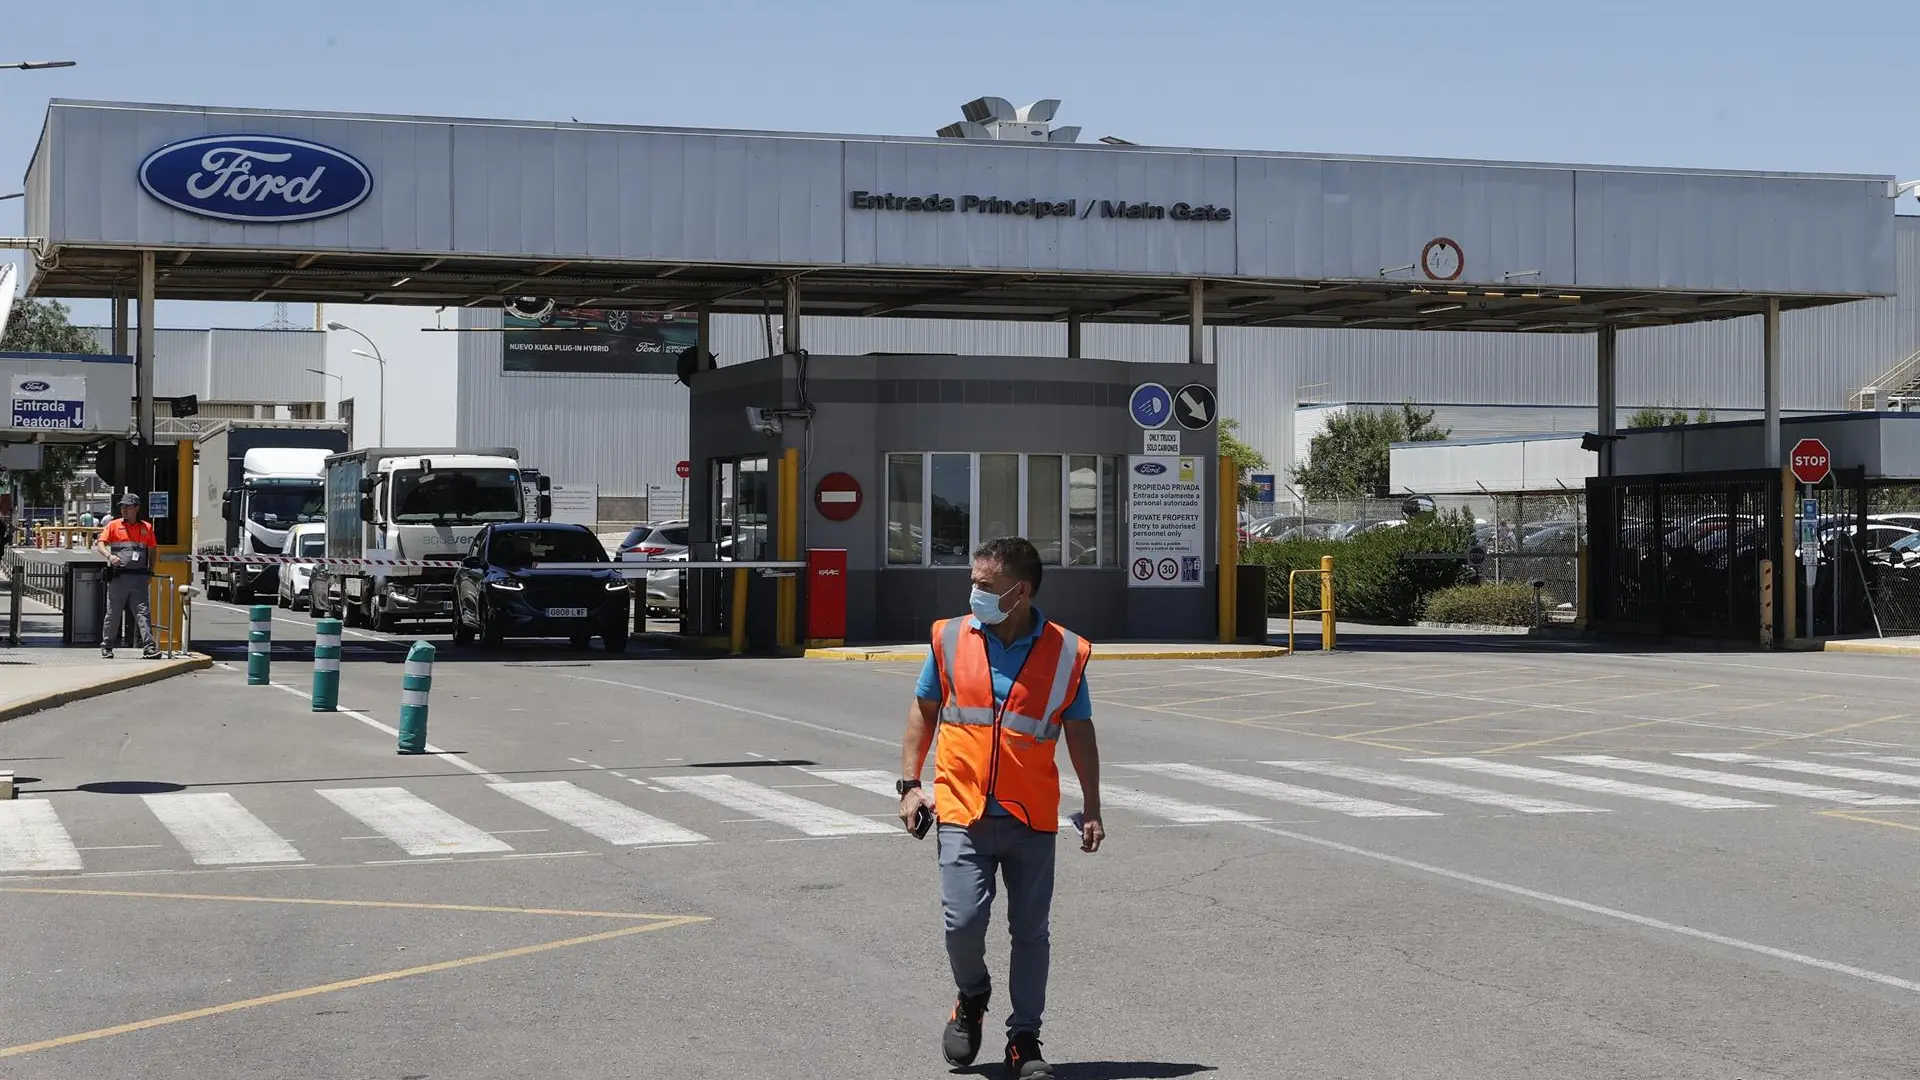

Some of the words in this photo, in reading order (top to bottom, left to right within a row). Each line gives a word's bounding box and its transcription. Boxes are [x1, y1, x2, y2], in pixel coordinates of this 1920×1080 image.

[186, 146, 326, 204] Ford
[850, 191, 956, 213] Entrada
[960, 194, 1076, 220] Principal
[1100, 200, 1165, 220] Main
[1170, 202, 1232, 222] Gate
[509, 343, 534, 351] NUEVO
[554, 344, 582, 352] PLUG-IN
[635, 341, 661, 353] Ford
[14, 399, 66, 412] Entrada
[13, 415, 71, 428] Peatonal
[1160, 434, 1177, 442] TRUCKS
[1146, 443, 1157, 452] SOLO
[1795, 456, 1827, 466] STOP
[1133, 522, 1150, 530] Entry
[1133, 530, 1166, 538] personnel
[1167, 530, 1182, 538] only
[1162, 564, 1174, 574] 30
